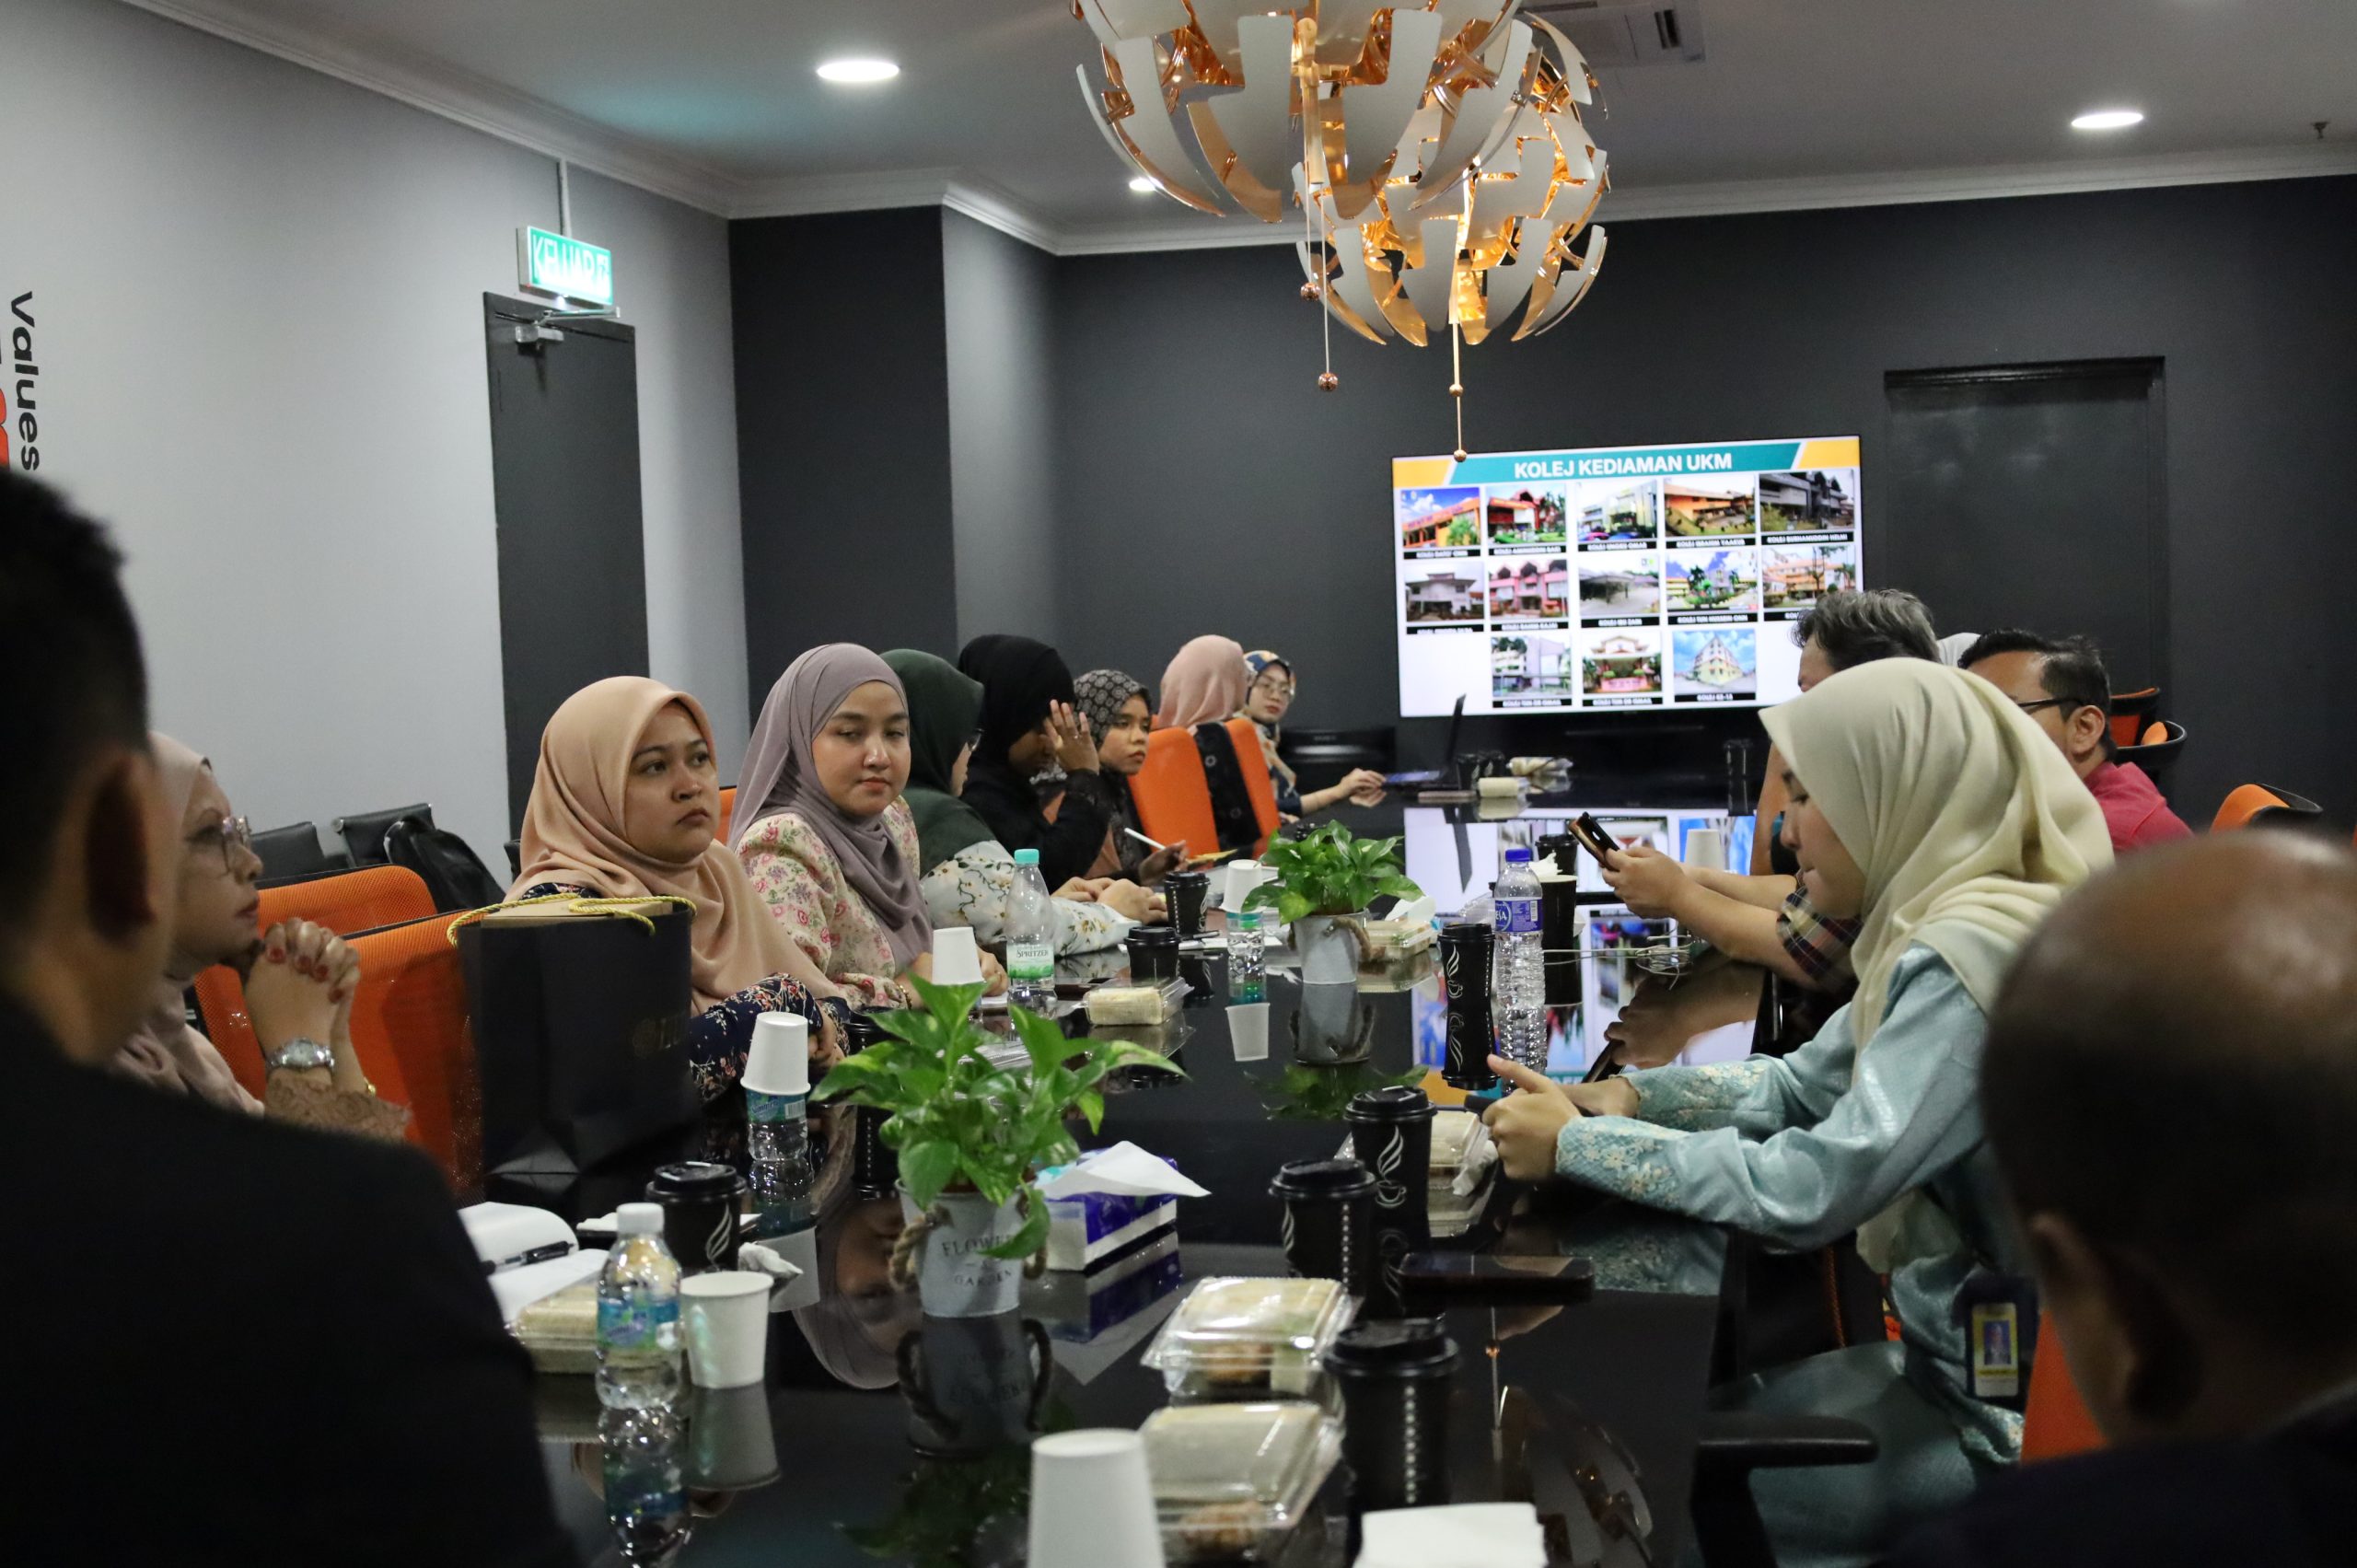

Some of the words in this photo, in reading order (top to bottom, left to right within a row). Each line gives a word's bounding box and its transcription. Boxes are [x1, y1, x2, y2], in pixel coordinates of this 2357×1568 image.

[11, 291, 40, 471] Values
[1515, 460, 1574, 479] KOLEJ
[1578, 455, 1682, 476] KEDIAMAN
[1686, 452, 1733, 471] UKM
[1016, 949, 1049, 958] SPRITZER
[942, 1234, 1010, 1257] FLOWE
